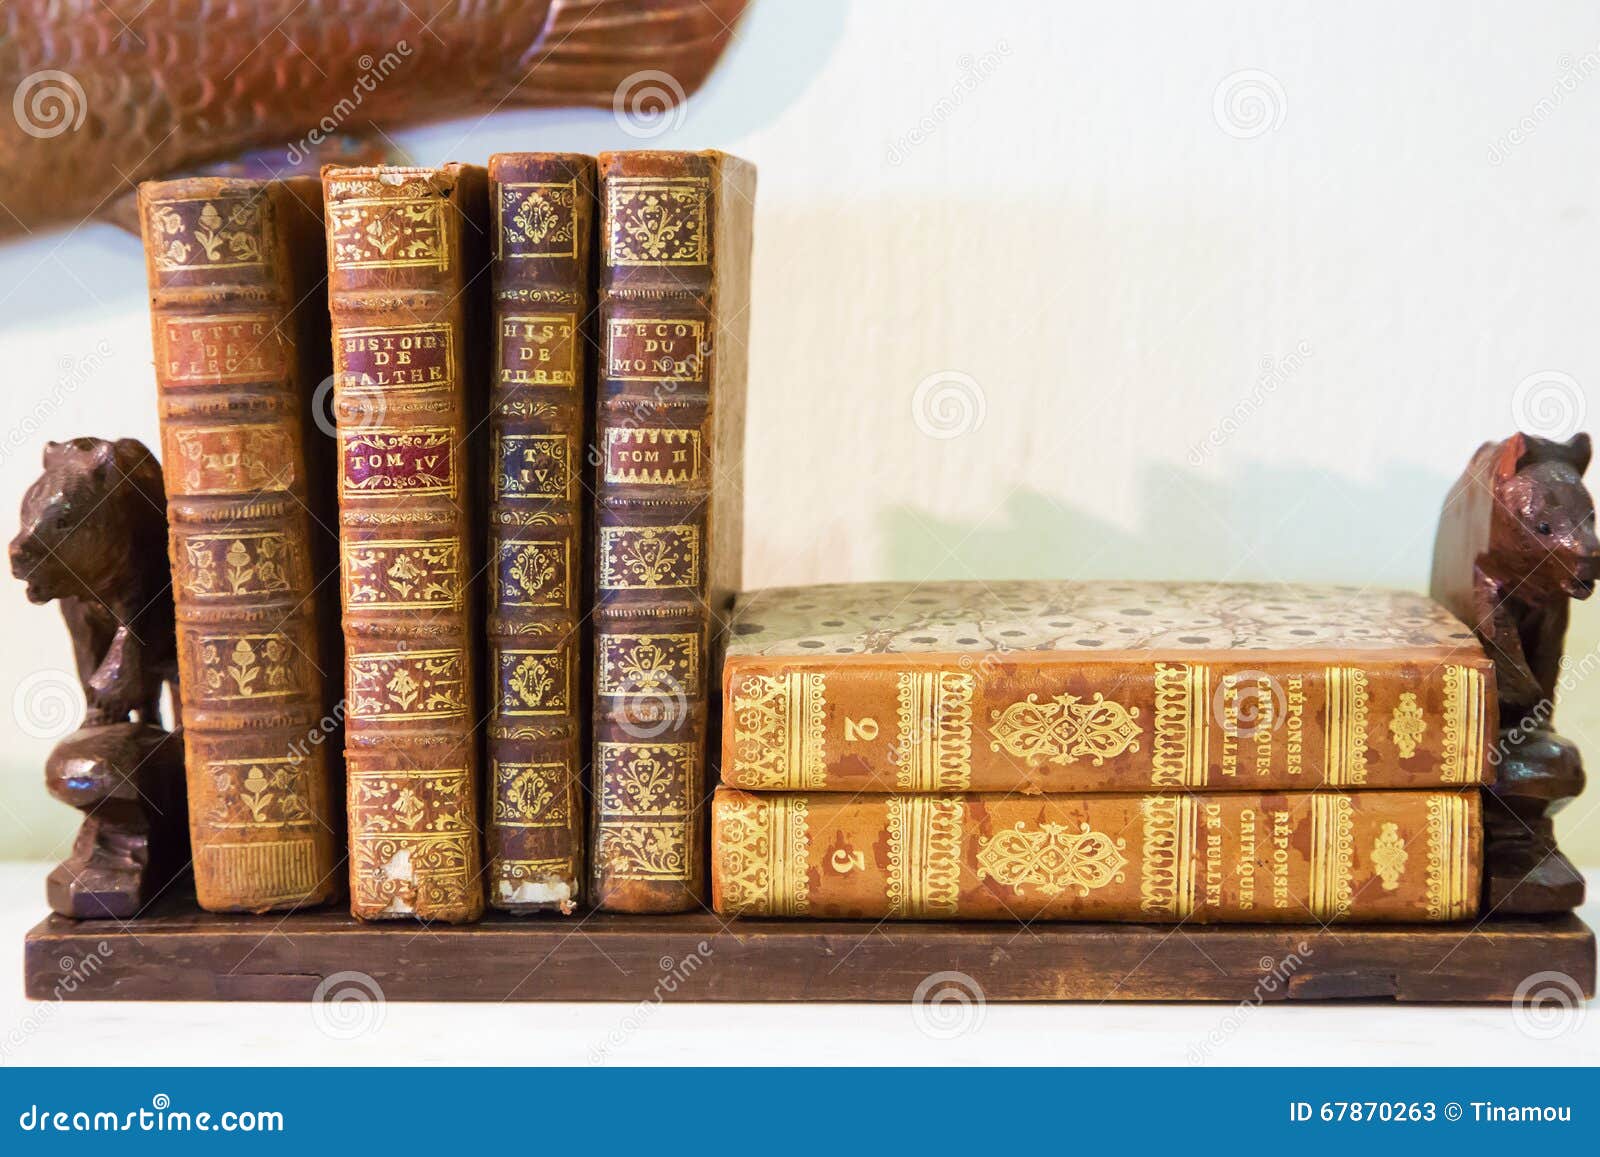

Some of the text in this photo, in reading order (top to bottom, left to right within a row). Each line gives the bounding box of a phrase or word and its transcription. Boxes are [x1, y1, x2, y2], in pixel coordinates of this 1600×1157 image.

[503, 324, 571, 338] HIST
[645, 340, 676, 353] DU
[374, 351, 412, 365] DE
[520, 348, 551, 361] DE
[352, 454, 439, 471] TOM IV
[618, 451, 659, 463] TOM
[520, 469, 548, 483] IV
[844, 717, 879, 741] 2
[1221, 675, 1237, 776] DE BULLET
[832, 849, 865, 873] 3
[1206, 803, 1221, 907] DE BULLET
[1236, 809, 1255, 910] CRITIQUES
